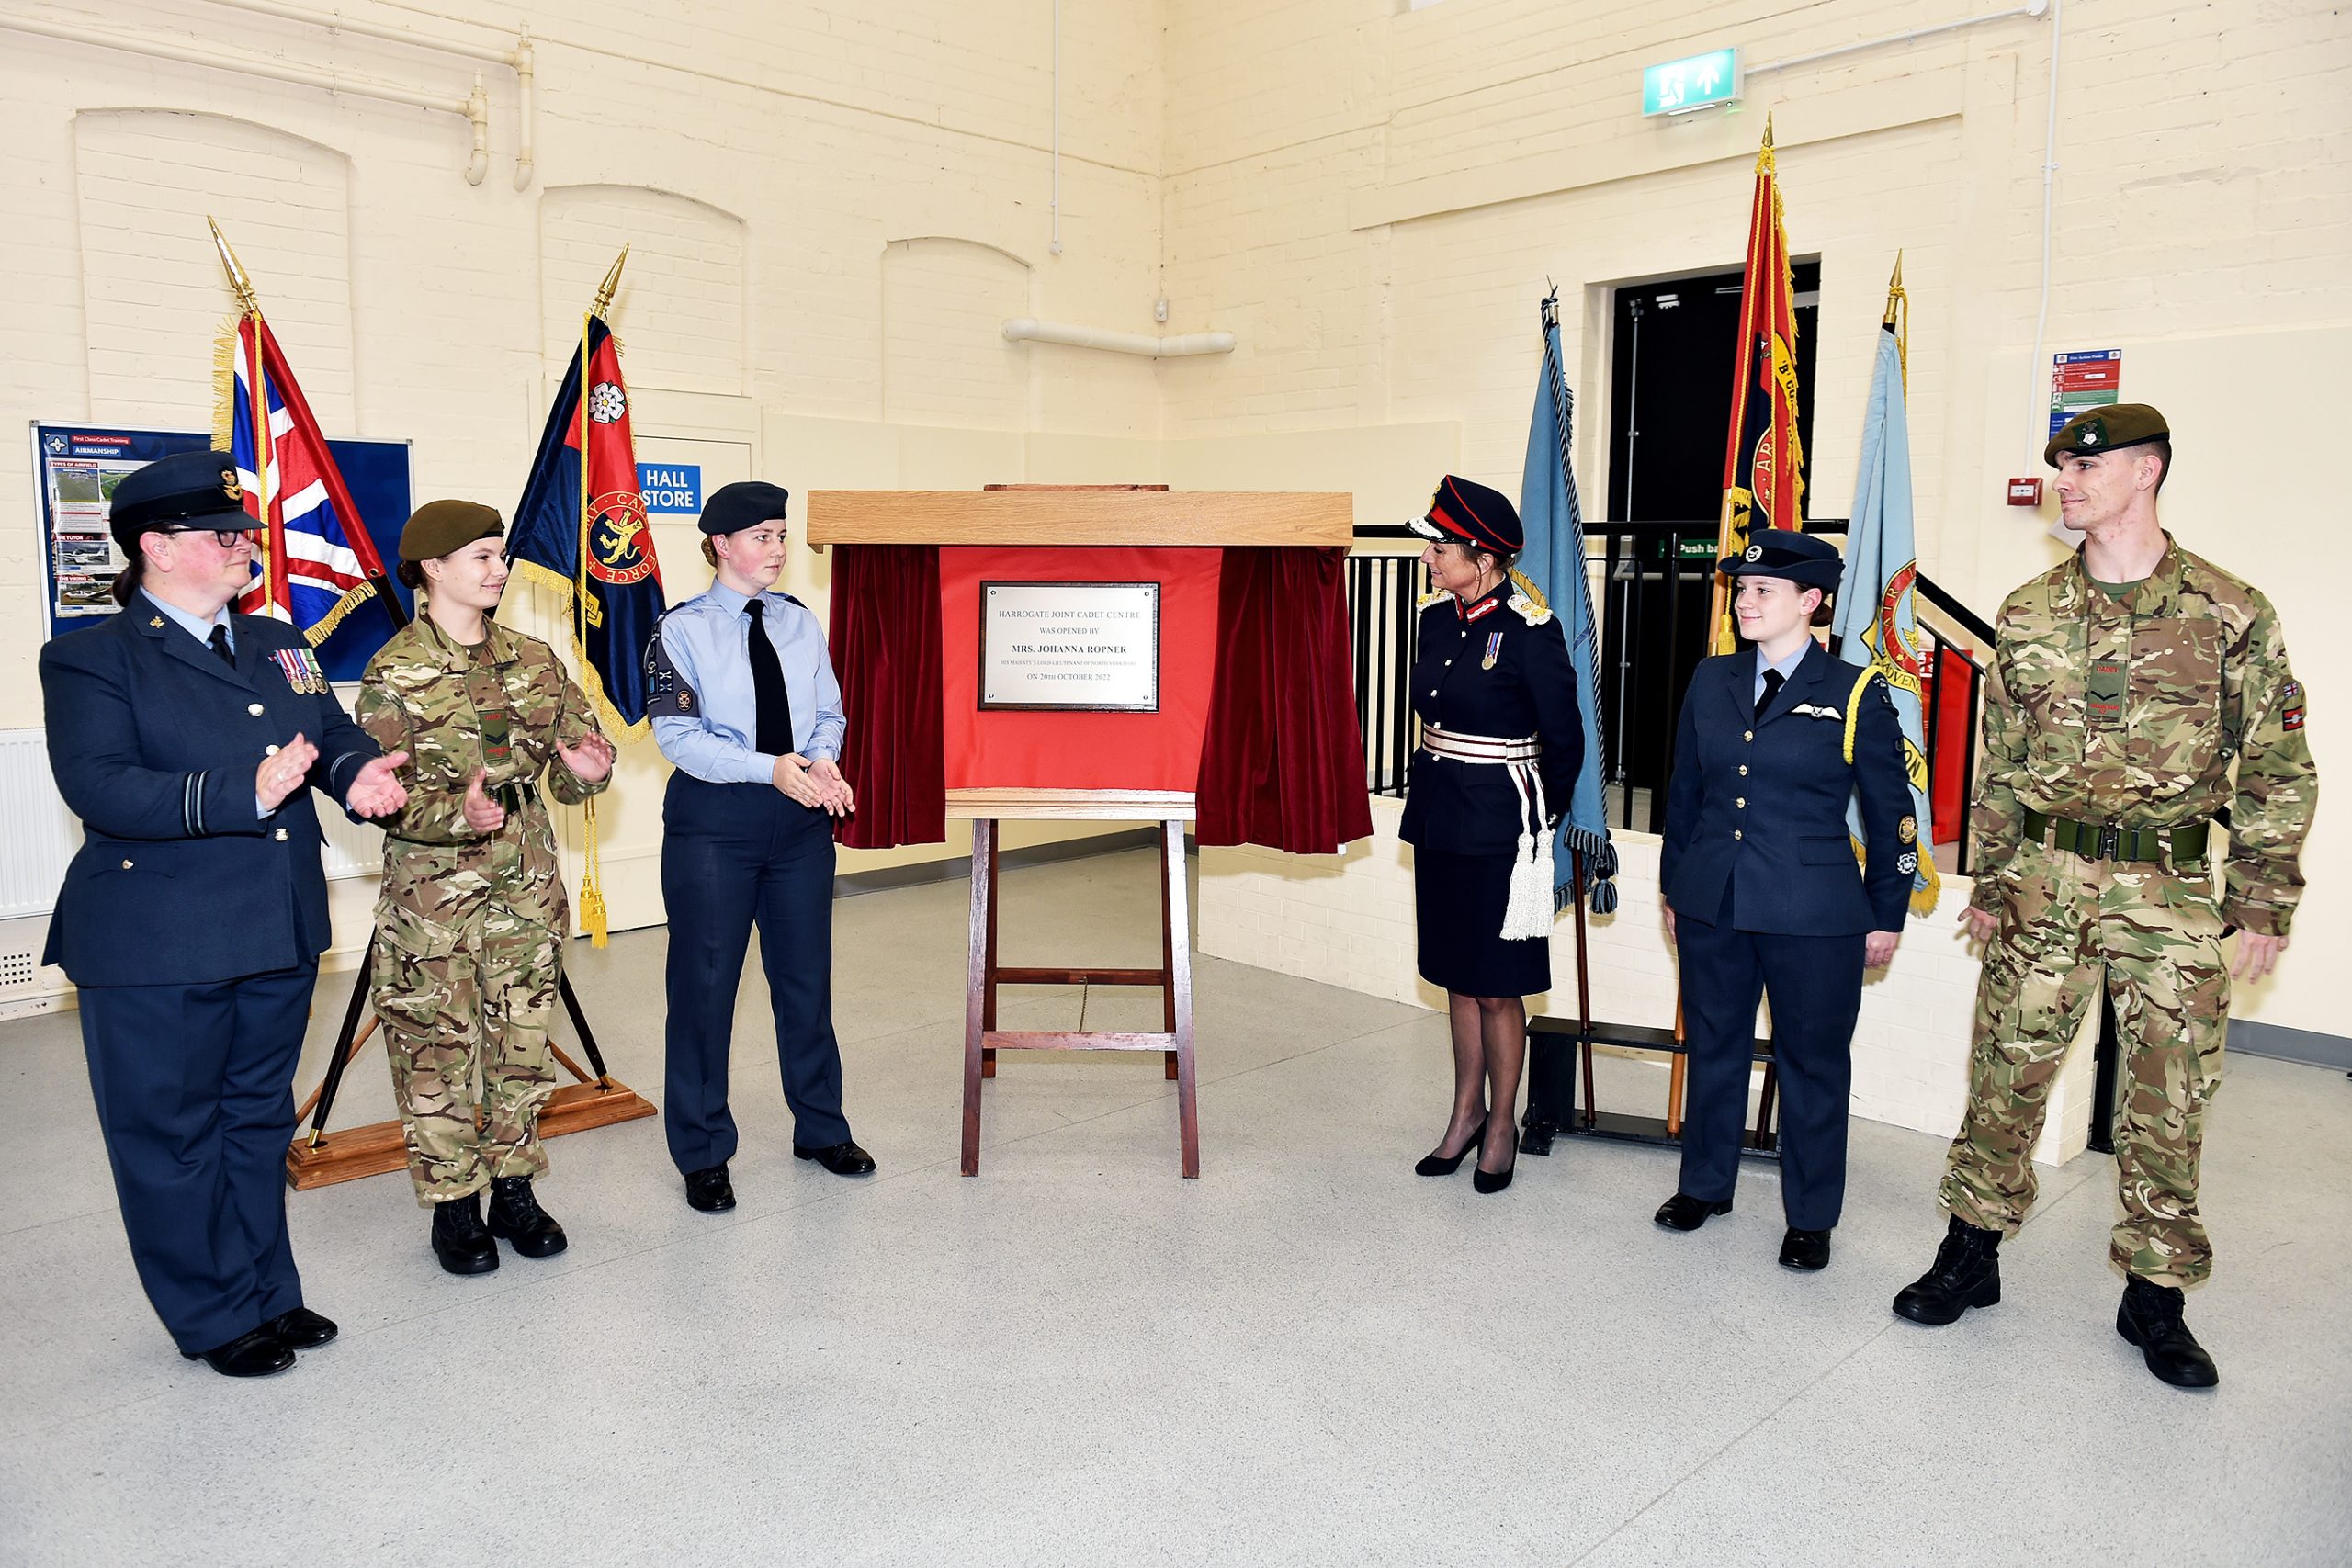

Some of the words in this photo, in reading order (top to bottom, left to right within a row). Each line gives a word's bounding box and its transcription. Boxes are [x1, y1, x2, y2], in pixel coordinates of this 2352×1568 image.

[646, 469, 688, 488] HALL
[641, 489, 694, 507] STORE
[999, 610, 1050, 618] HARROGATE
[1051, 610, 1075, 618] JOINT
[1077, 610, 1104, 618] CADET
[1106, 611, 1141, 619] CENTRE
[1057, 626, 1088, 635] OPENED
[1012, 645, 1035, 653] MRS.
[1037, 645, 1083, 653] JOHANNA
[1882, 661, 1919, 692] ADVEN
